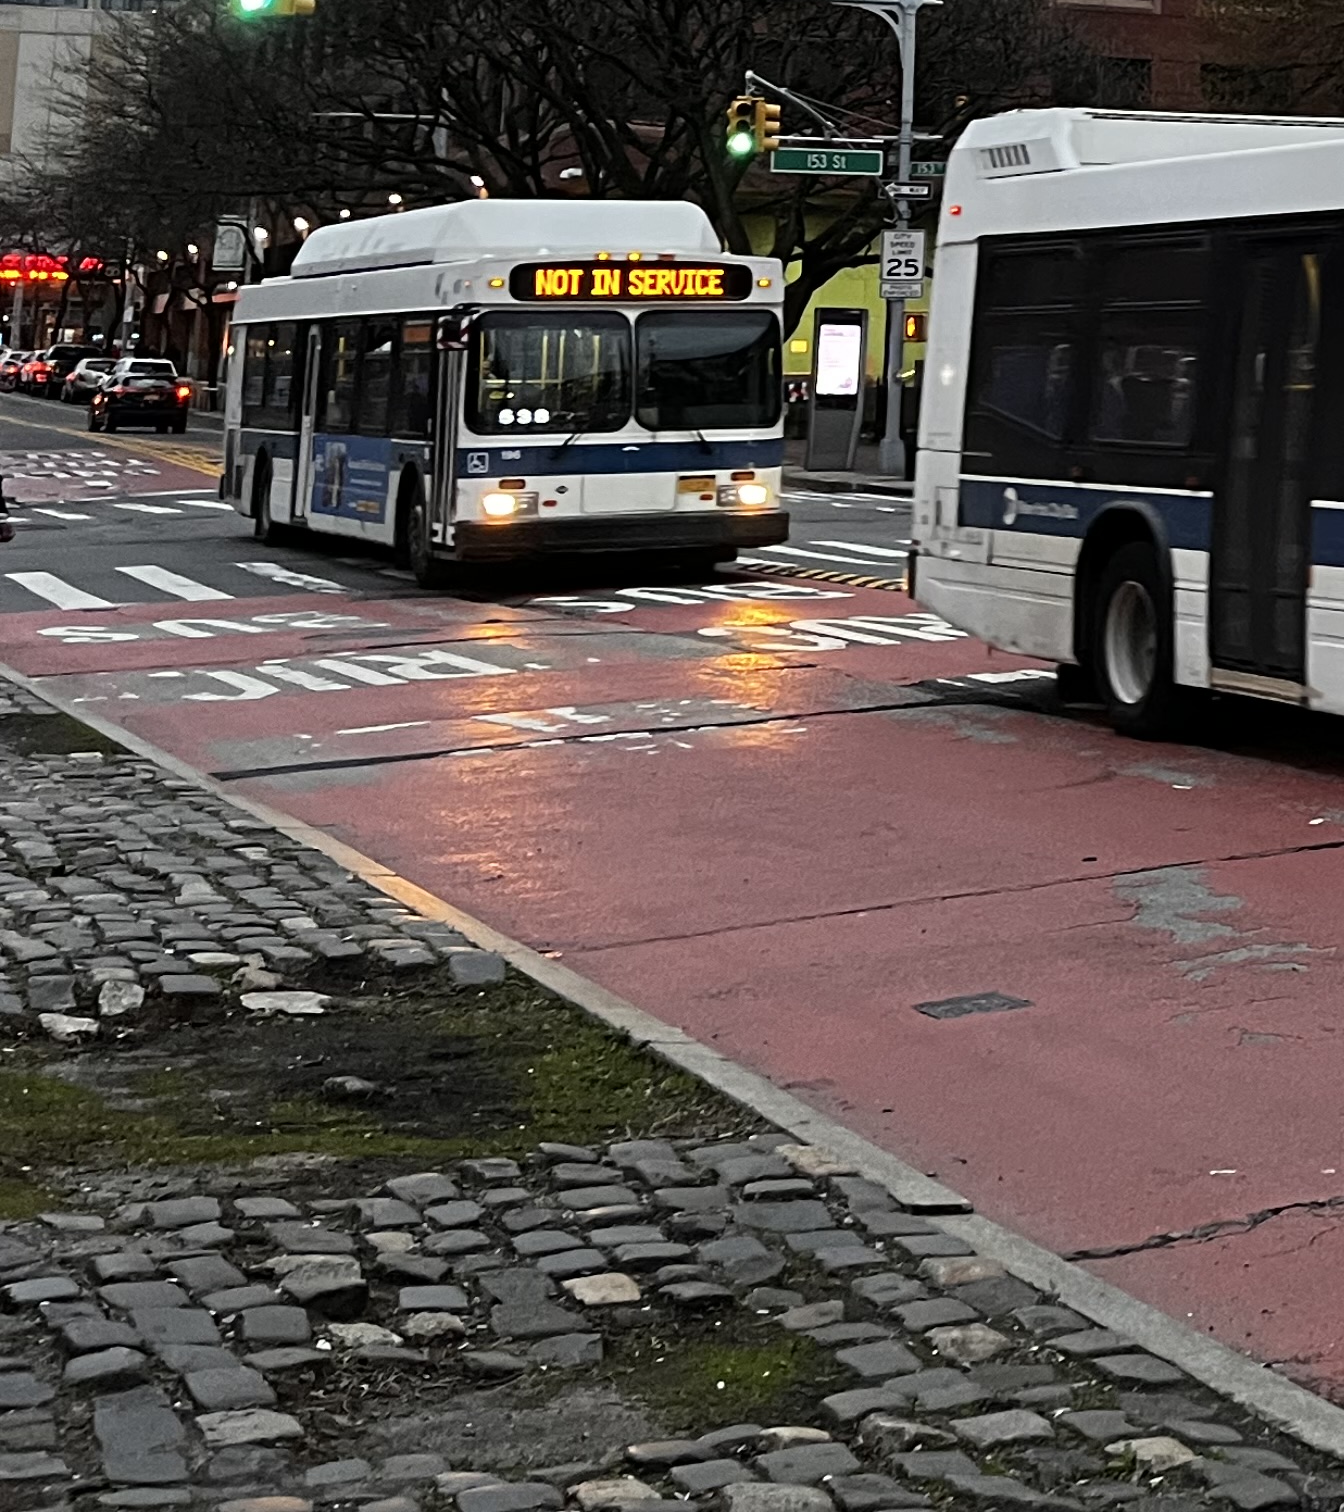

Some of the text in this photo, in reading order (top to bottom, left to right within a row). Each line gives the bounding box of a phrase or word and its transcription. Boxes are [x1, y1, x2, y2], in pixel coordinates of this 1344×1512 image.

[807, 153, 847, 169] 153 St
[886, 258, 919, 277] 25
[535, 269, 725, 296] NOT IN SERVICE
